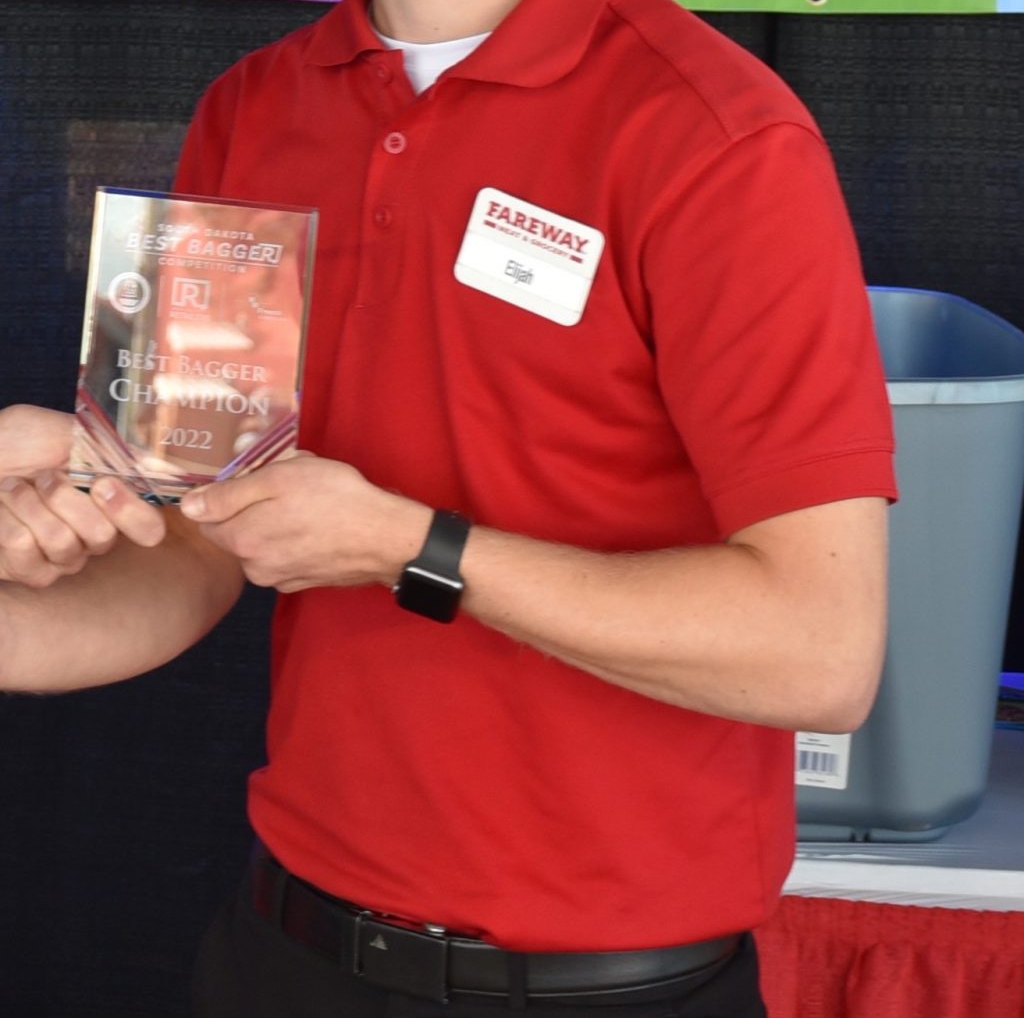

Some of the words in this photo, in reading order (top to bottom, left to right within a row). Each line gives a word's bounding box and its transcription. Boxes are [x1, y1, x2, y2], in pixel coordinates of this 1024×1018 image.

[204, 228, 255, 241] DAKOTA
[486, 201, 590, 253] FAREWAY
[126, 232, 183, 252] BEST
[187, 239, 284, 263] BAGGER
[158, 256, 248, 274] COMPETITION
[503, 259, 535, 285] Elijah
[117, 348, 171, 372] BEST
[176, 355, 268, 383] BAGGER
[108, 378, 270, 416] CHMPION
[160, 428, 213, 450] 2022
